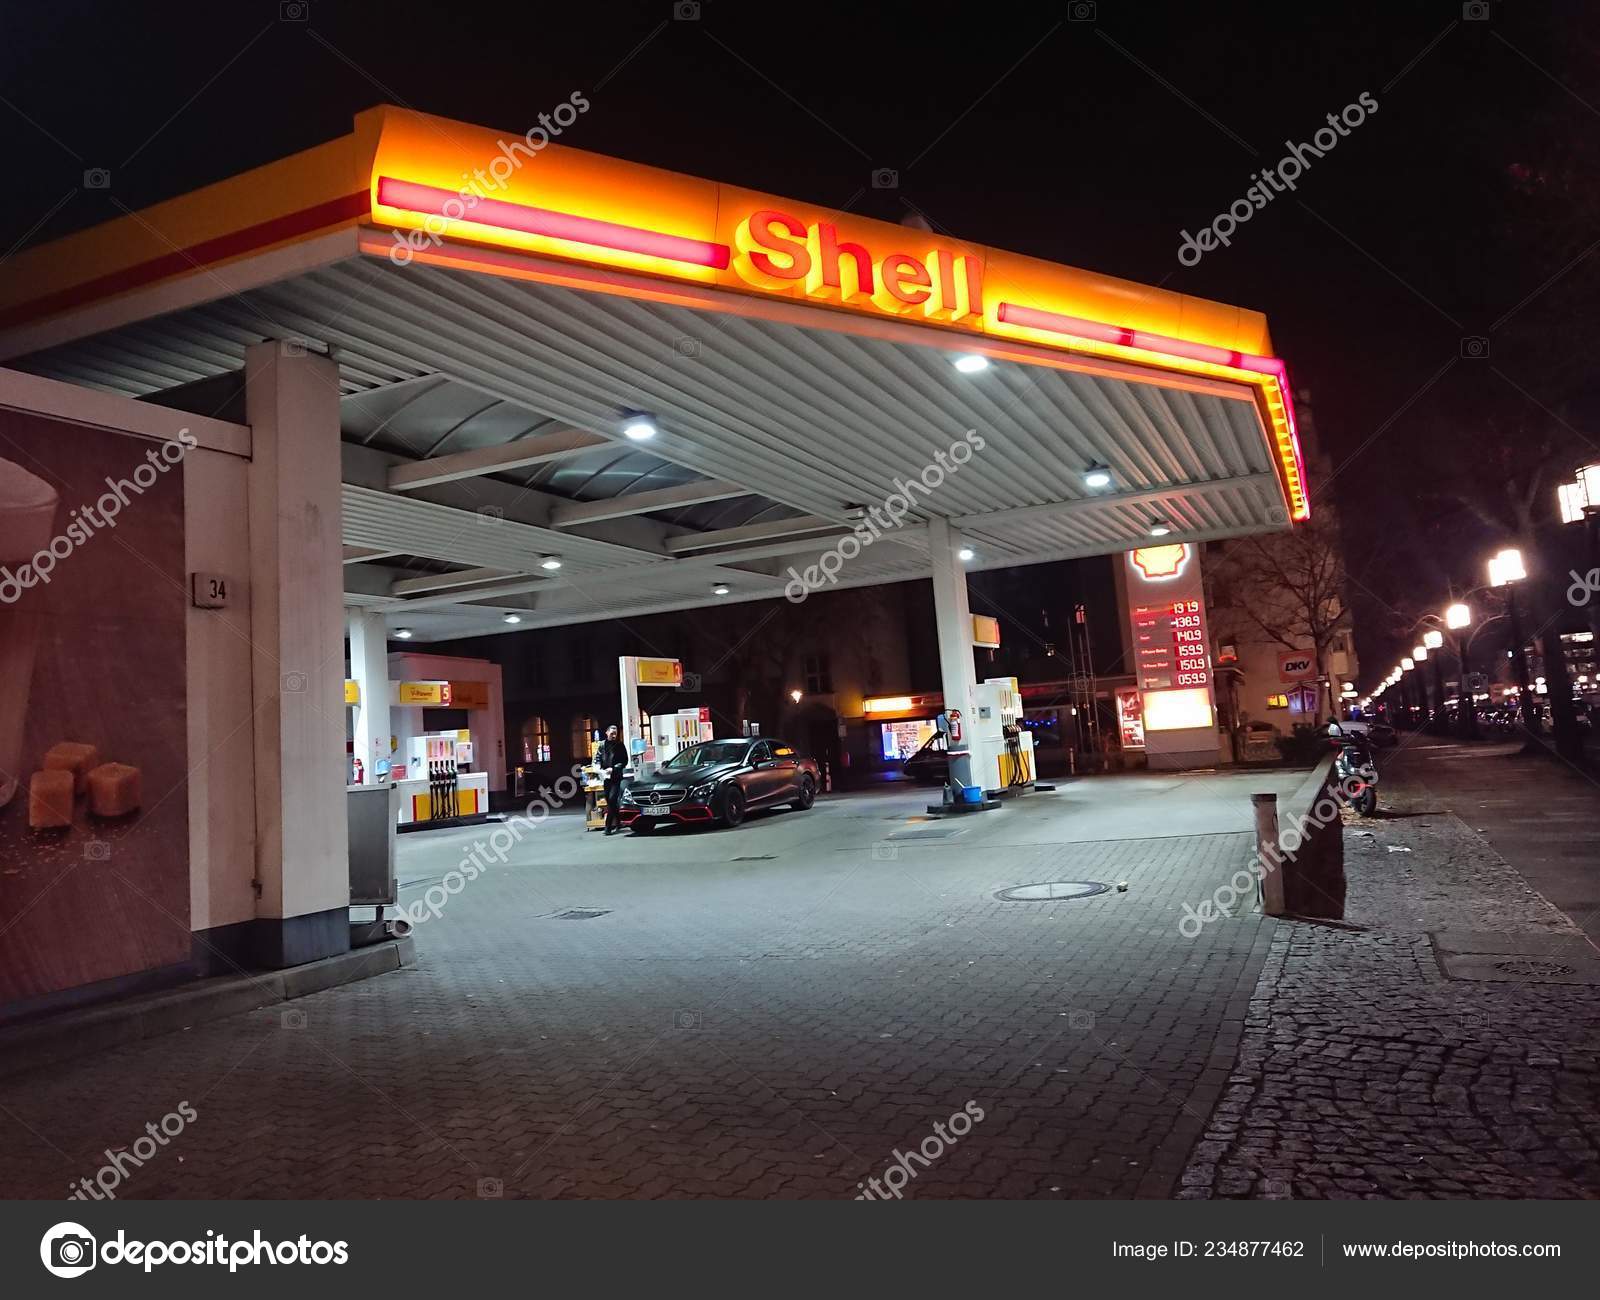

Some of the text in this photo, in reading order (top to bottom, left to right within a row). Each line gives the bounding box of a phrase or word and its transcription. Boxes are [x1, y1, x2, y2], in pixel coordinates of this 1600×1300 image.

[742, 210, 985, 318] Shell
[210, 580, 226, 599] 34
[1285, 660, 1310, 671] DKV
[442, 687, 449, 700] 5
